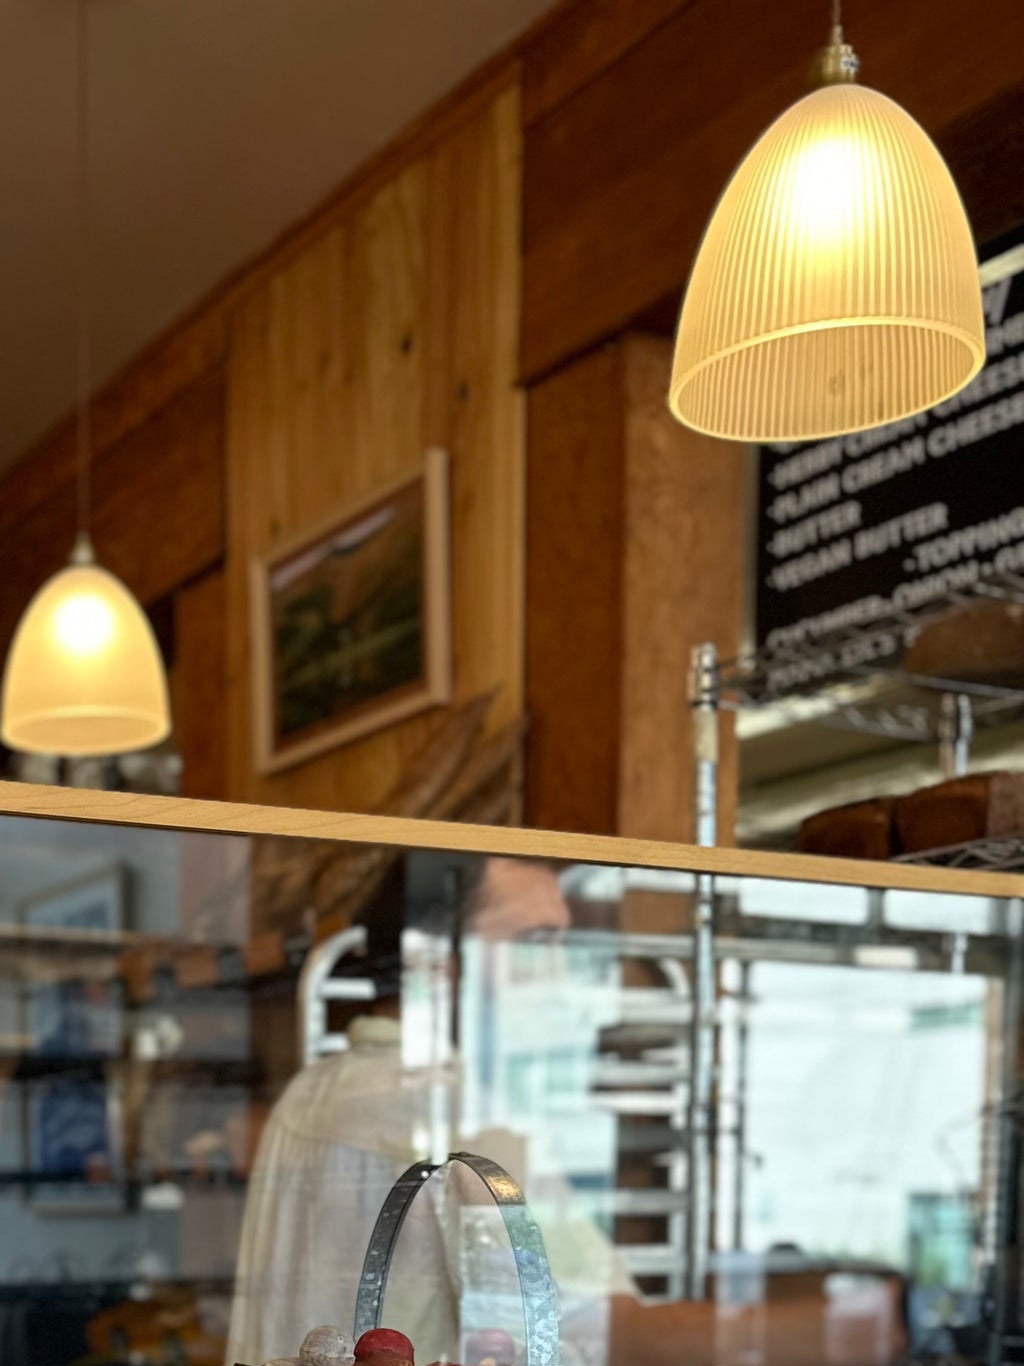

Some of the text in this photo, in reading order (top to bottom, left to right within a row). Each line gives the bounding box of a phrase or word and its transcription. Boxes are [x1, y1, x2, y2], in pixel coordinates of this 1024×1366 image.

[773, 471, 840, 523] PLAIN
[841, 434, 925, 494] CREAM
[772, 537, 851, 591] VEGAN
[853, 501, 948, 560] BUTTER
[773, 499, 862, 557] BUTTER
